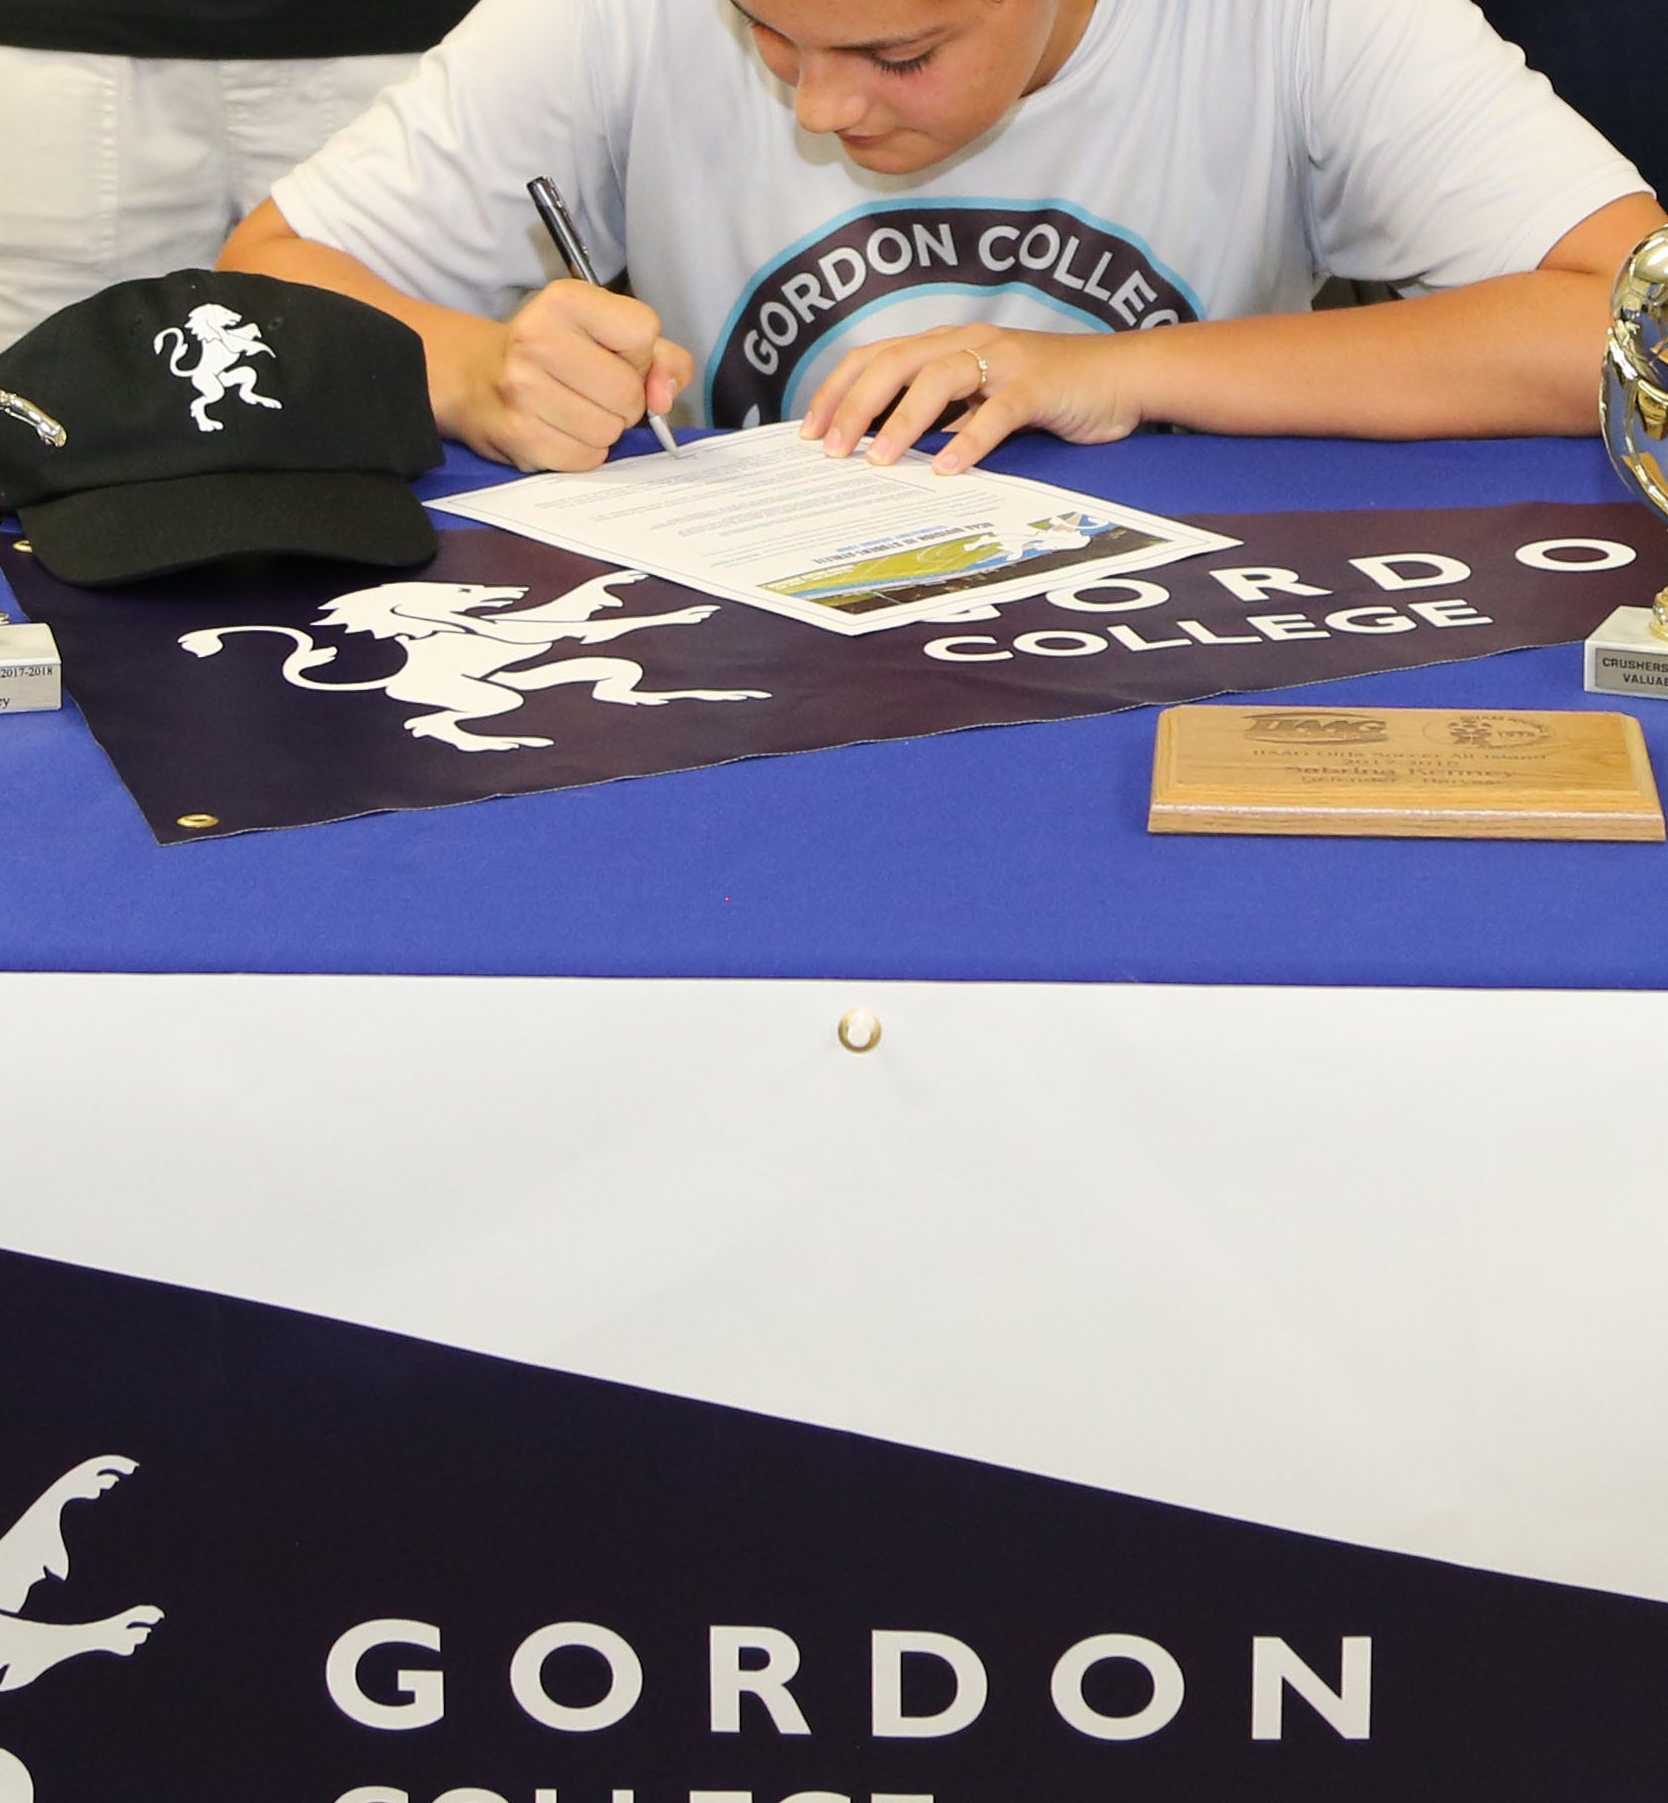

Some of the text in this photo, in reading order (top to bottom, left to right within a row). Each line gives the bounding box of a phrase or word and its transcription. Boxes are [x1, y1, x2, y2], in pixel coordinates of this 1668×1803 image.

[744, 222, 1179, 376] GORDON COLLE
[923, 598, 1494, 662] COLLEGE
[0, 667, 53, 678] 2017-2018
[1602, 658, 1668, 673] CRUSHERS
[325, 1618, 1372, 1742] GORDON
